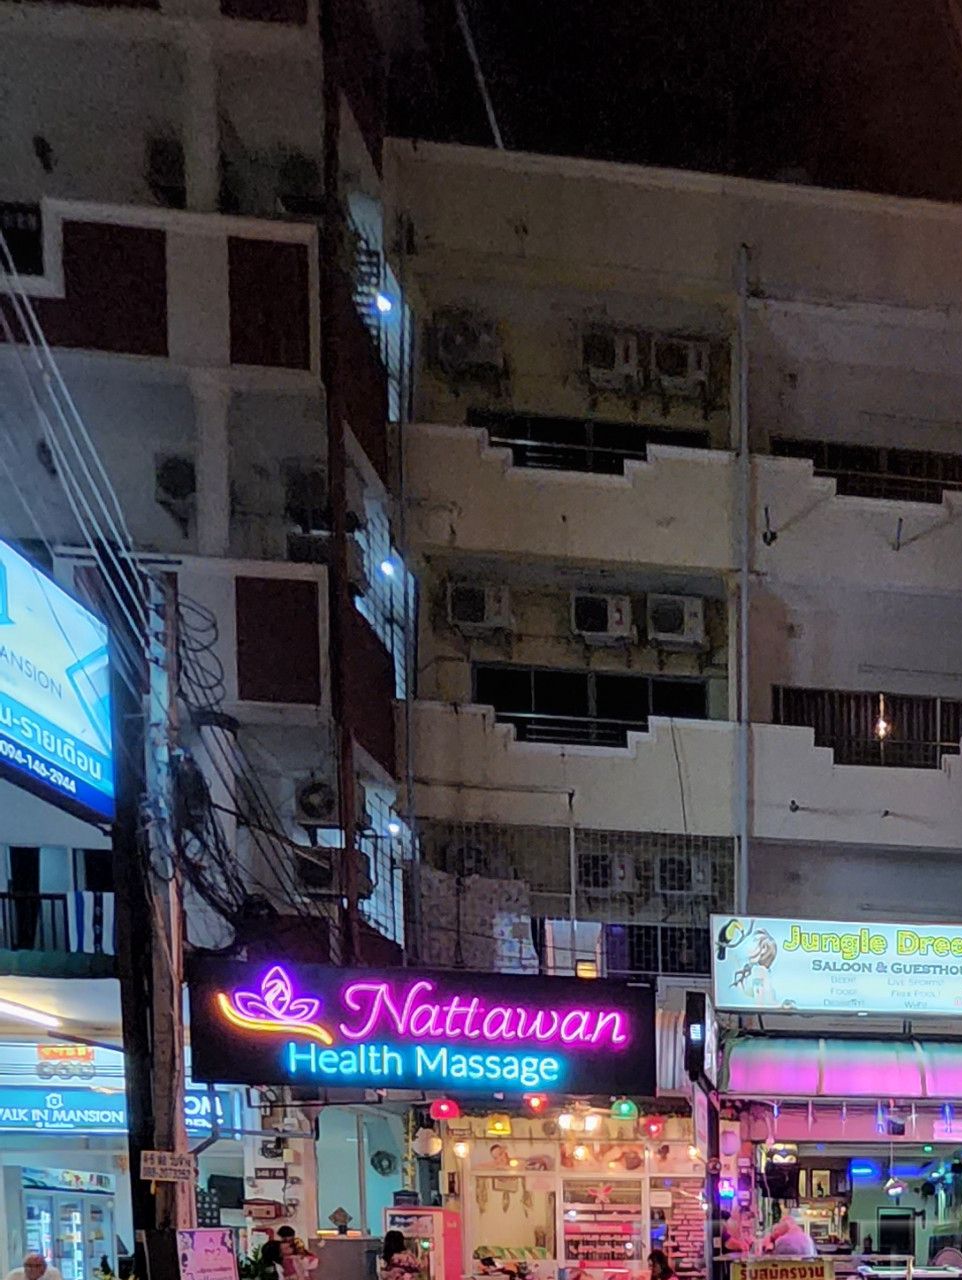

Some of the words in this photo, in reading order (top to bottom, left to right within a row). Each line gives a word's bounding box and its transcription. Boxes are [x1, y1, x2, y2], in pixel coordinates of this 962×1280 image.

[0, 646, 62, 699] ANSION
[783, 925, 888, 960] Jungle
[812, 959, 872, 973] SALOON
[876, 961, 888, 972] &
[339, 980, 628, 1044] Nattawan
[288, 1043, 403, 1078] Health
[416, 1046, 560, 1086] Massage
[31, 1109, 49, 1122] IN
[52, 1109, 124, 1124] MANSION
[740, 1263, 825, 1280] รับสมัครงาน
